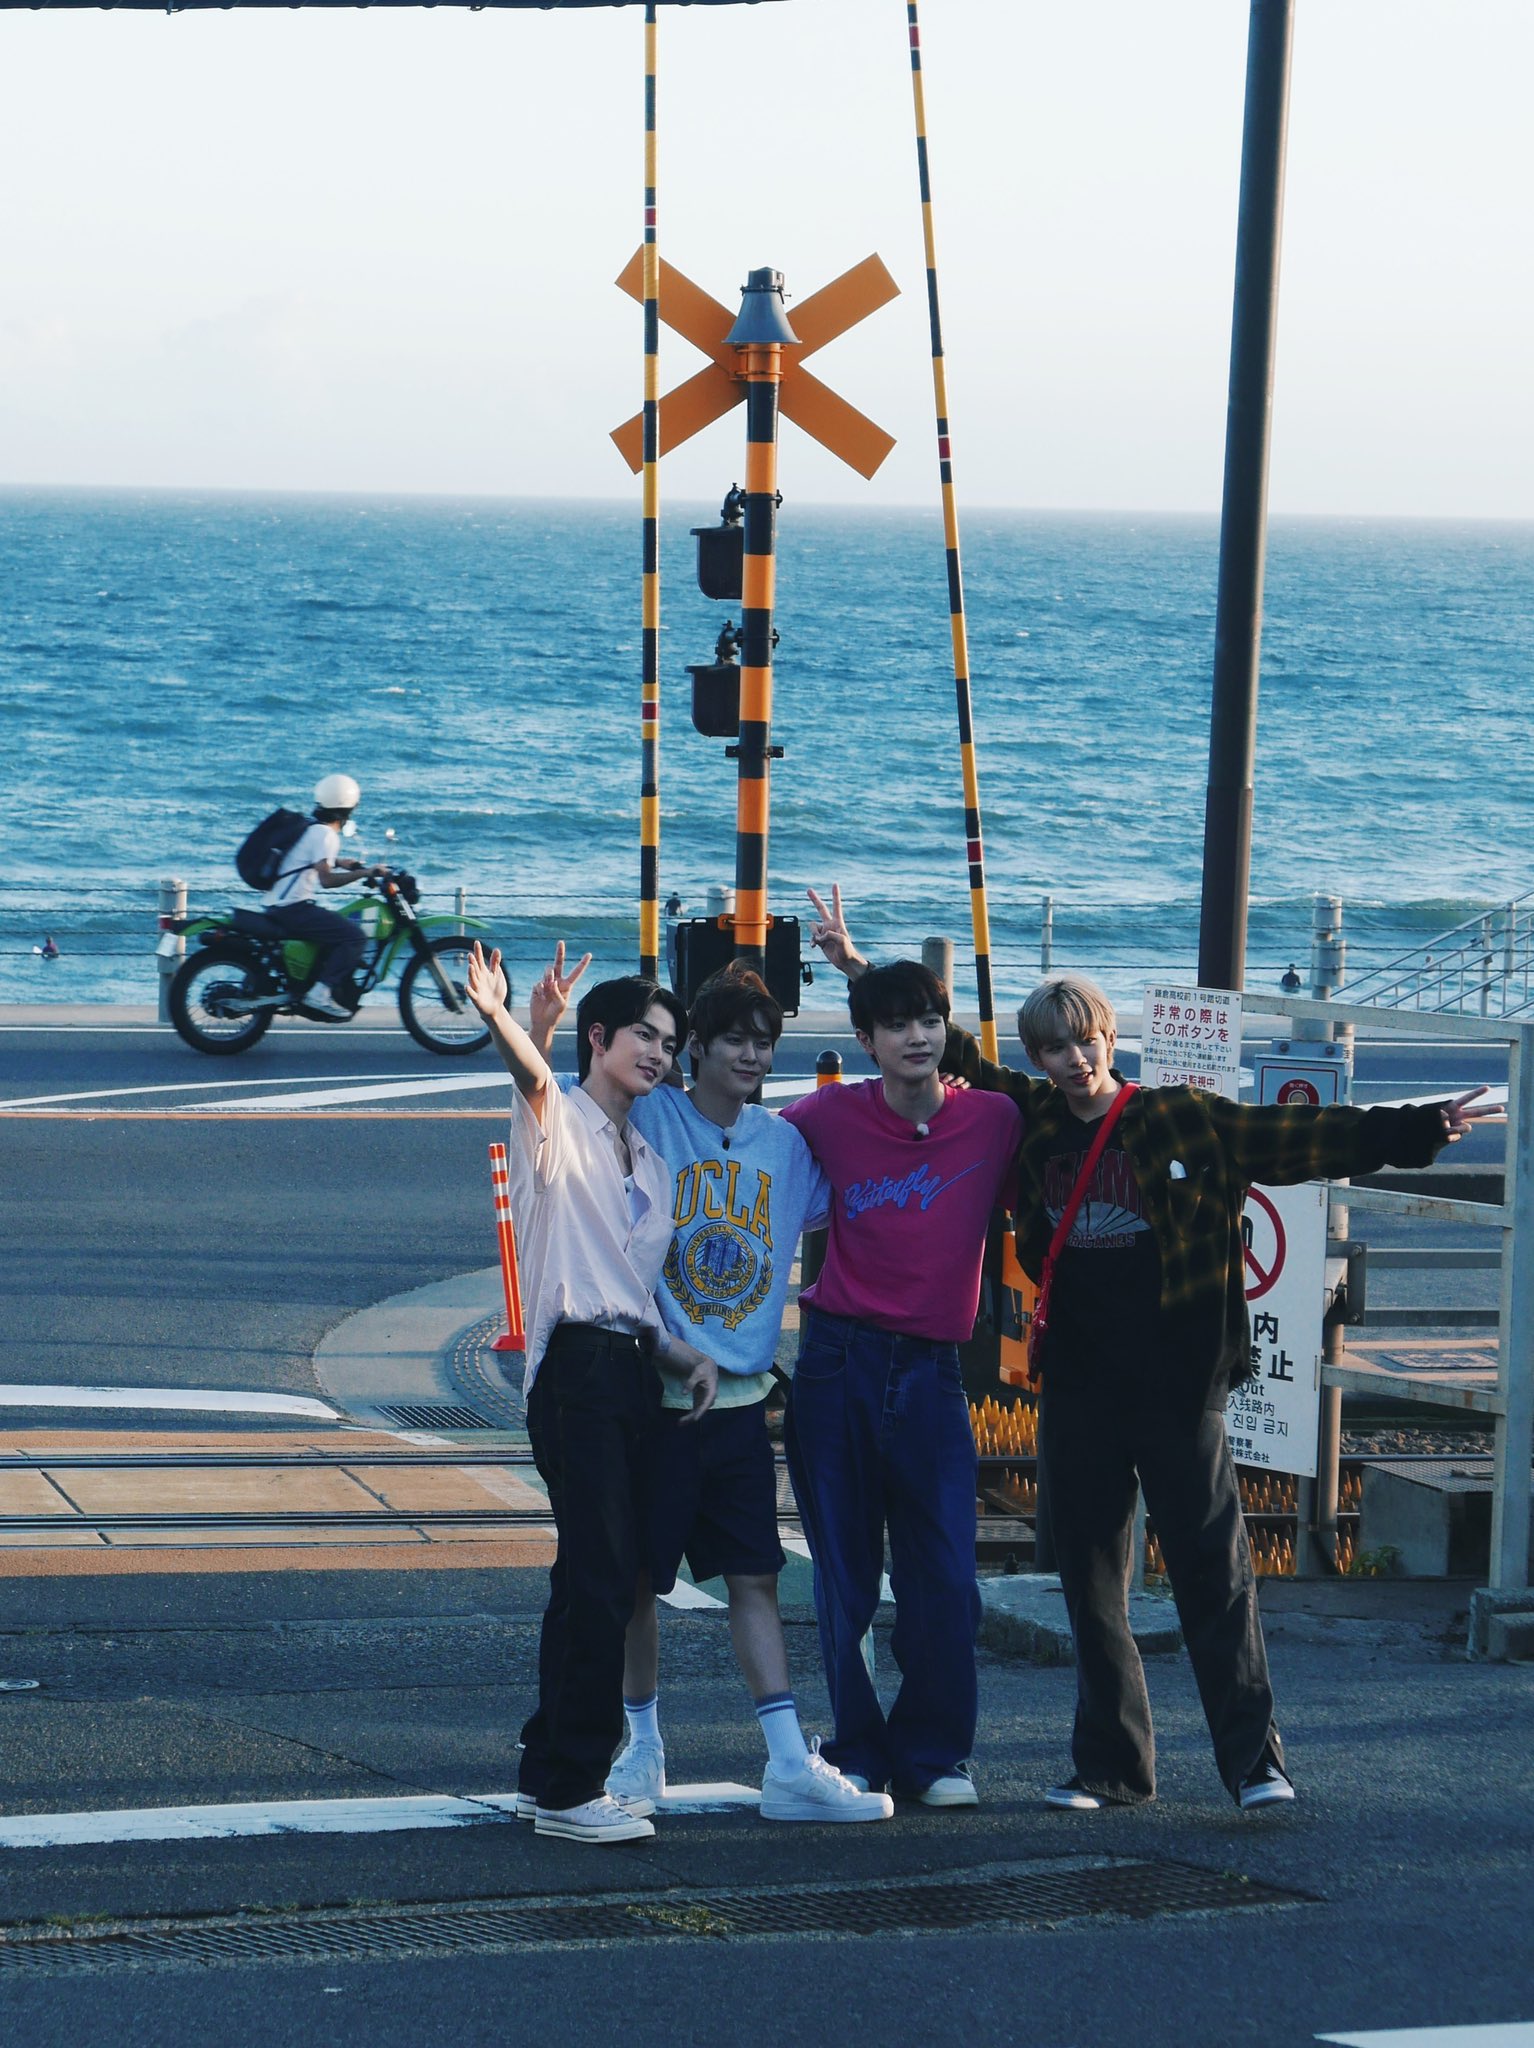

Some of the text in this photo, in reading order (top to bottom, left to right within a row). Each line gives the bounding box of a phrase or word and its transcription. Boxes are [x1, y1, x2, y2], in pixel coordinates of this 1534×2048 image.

[1153, 1003, 1228, 1025] 非常の際は
[1152, 1021, 1229, 1042] このボタンを
[1162, 1072, 1216, 1088] カメラ監視中
[844, 1160, 984, 1219] Butterfly
[674, 1159, 773, 1252] UCLA
[688, 1225, 728, 1256] UNIVERSITY
[699, 1304, 733, 1319] BRUINS
[1233, 1413, 1288, 1437] 진입 금지
